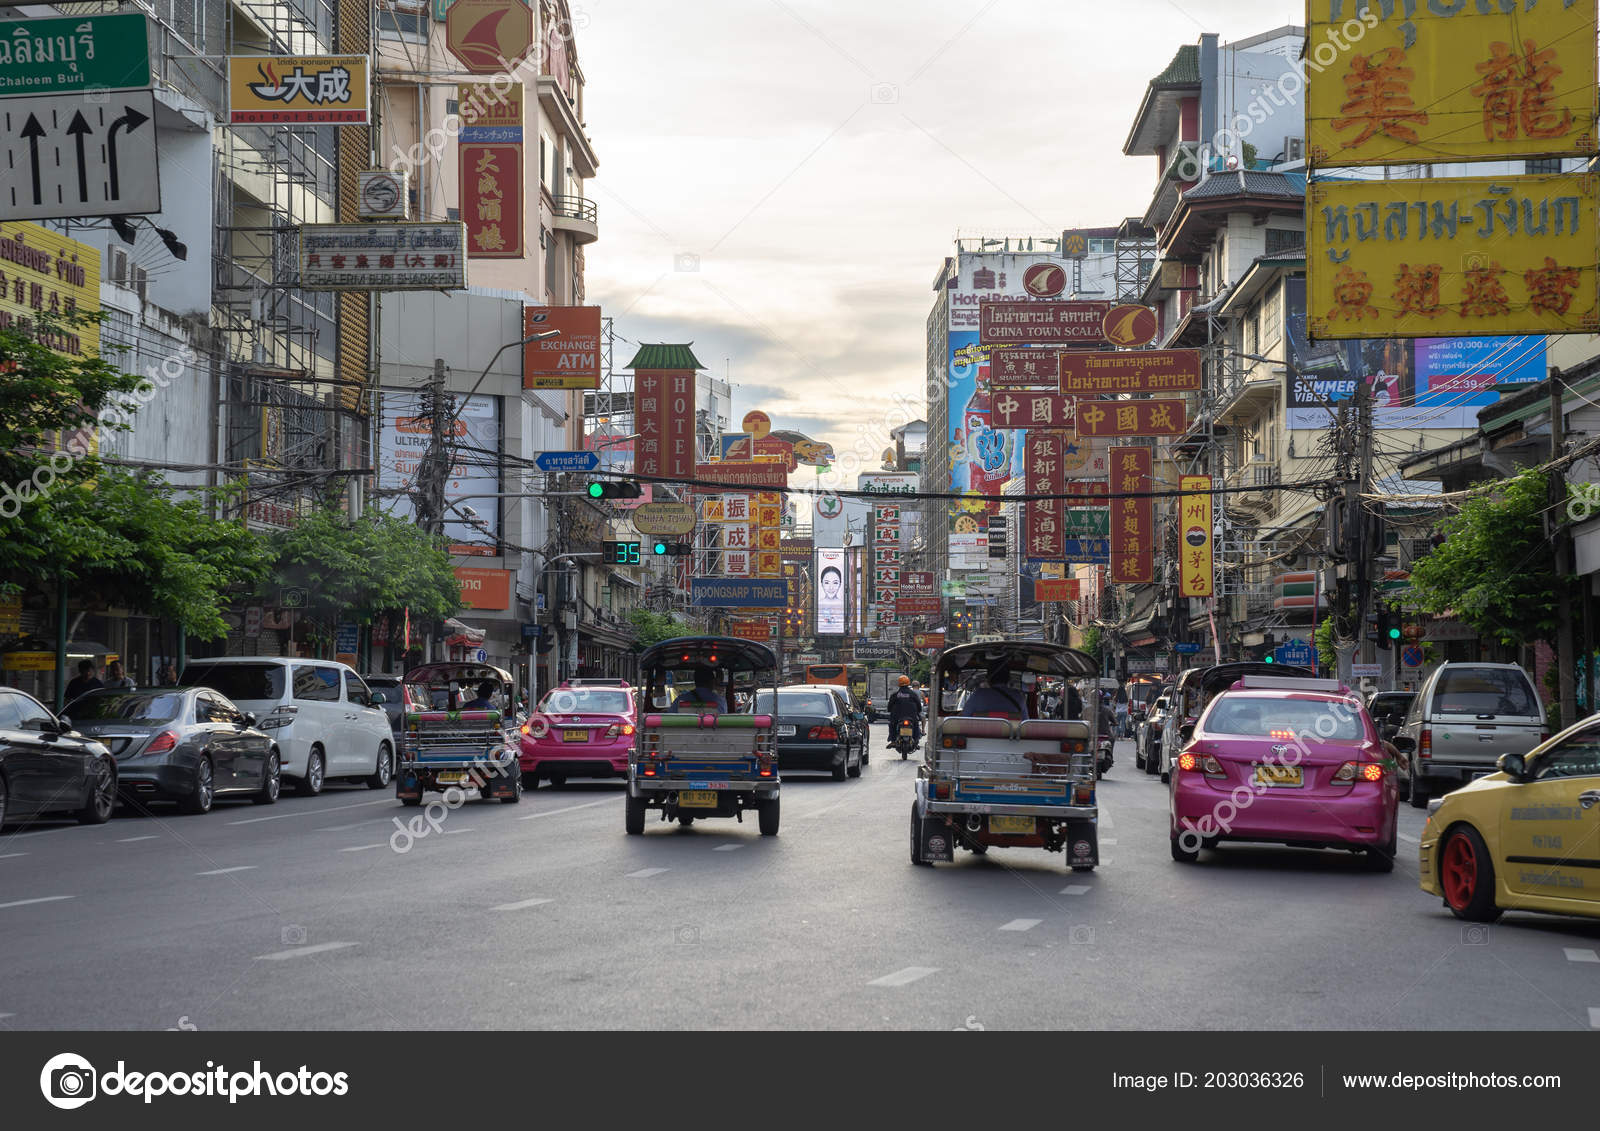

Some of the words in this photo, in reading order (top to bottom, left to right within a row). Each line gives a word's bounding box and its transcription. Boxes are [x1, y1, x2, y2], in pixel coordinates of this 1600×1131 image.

[0, 74, 52, 87] Chaloem
[57, 72, 85, 84] Buri
[281, 66, 352, 105] 大成
[235, 113, 264, 122] Hot
[272, 113, 298, 122] Pot
[307, 112, 362, 122] Buffet
[1322, 184, 1580, 263] หูฉลาม-รังนก
[988, 328, 1023, 337] CHINA
[1026, 328, 1061, 337] TOWN
[1064, 328, 1101, 337] SCALA
[540, 340, 596, 350] EXCHANGE
[556, 353, 595, 369] ATM
[1064, 370, 1141, 389] ไชน่าทาวน์
[1293, 380, 1356, 393] SUMMER
[1452, 380, 1478, 389] 2.39
[1294, 392, 1329, 402] VIBES
[997, 395, 1077, 425] 中國城
[1083, 404, 1176, 434] 中國城
[641, 375, 659, 474] 中國大酒店
[674, 377, 686, 475] HOTEL
[1032, 439, 1059, 553] 銀都魚翅酒樓
[1121, 453, 1142, 578] 銀都魚翅酒樓
[727, 499, 746, 573] 振成豐
[616, 543, 639, 563] 35
[694, 586, 749, 599] BOONGSARP
[752, 586, 784, 599] TRAVEL
[901, 583, 916, 591] Hotel
[917, 583, 932, 591] Royal
